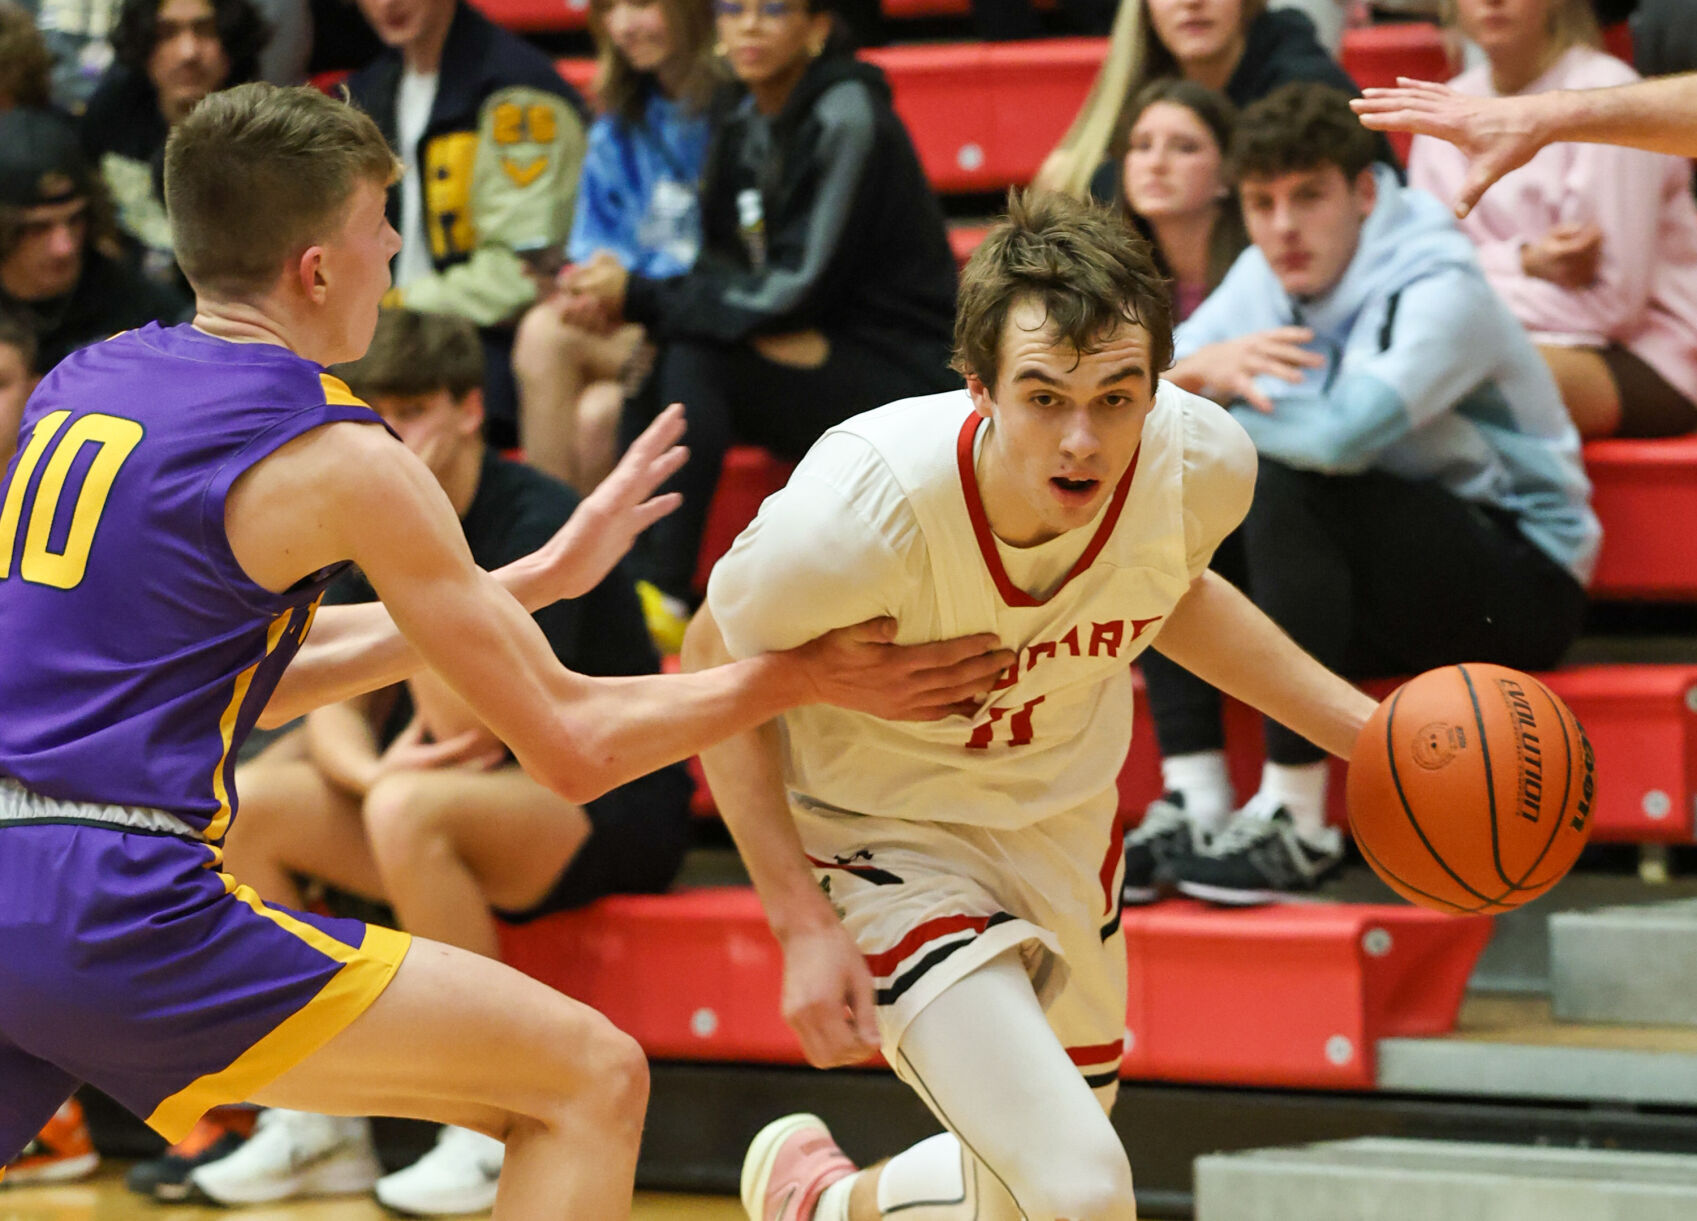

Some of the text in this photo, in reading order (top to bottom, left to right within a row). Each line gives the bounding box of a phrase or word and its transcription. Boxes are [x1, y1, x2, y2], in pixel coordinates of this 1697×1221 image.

[0, 410, 145, 590] 10
[964, 694, 1046, 749] 11
[1499, 678, 1542, 823] EVOLUTION
